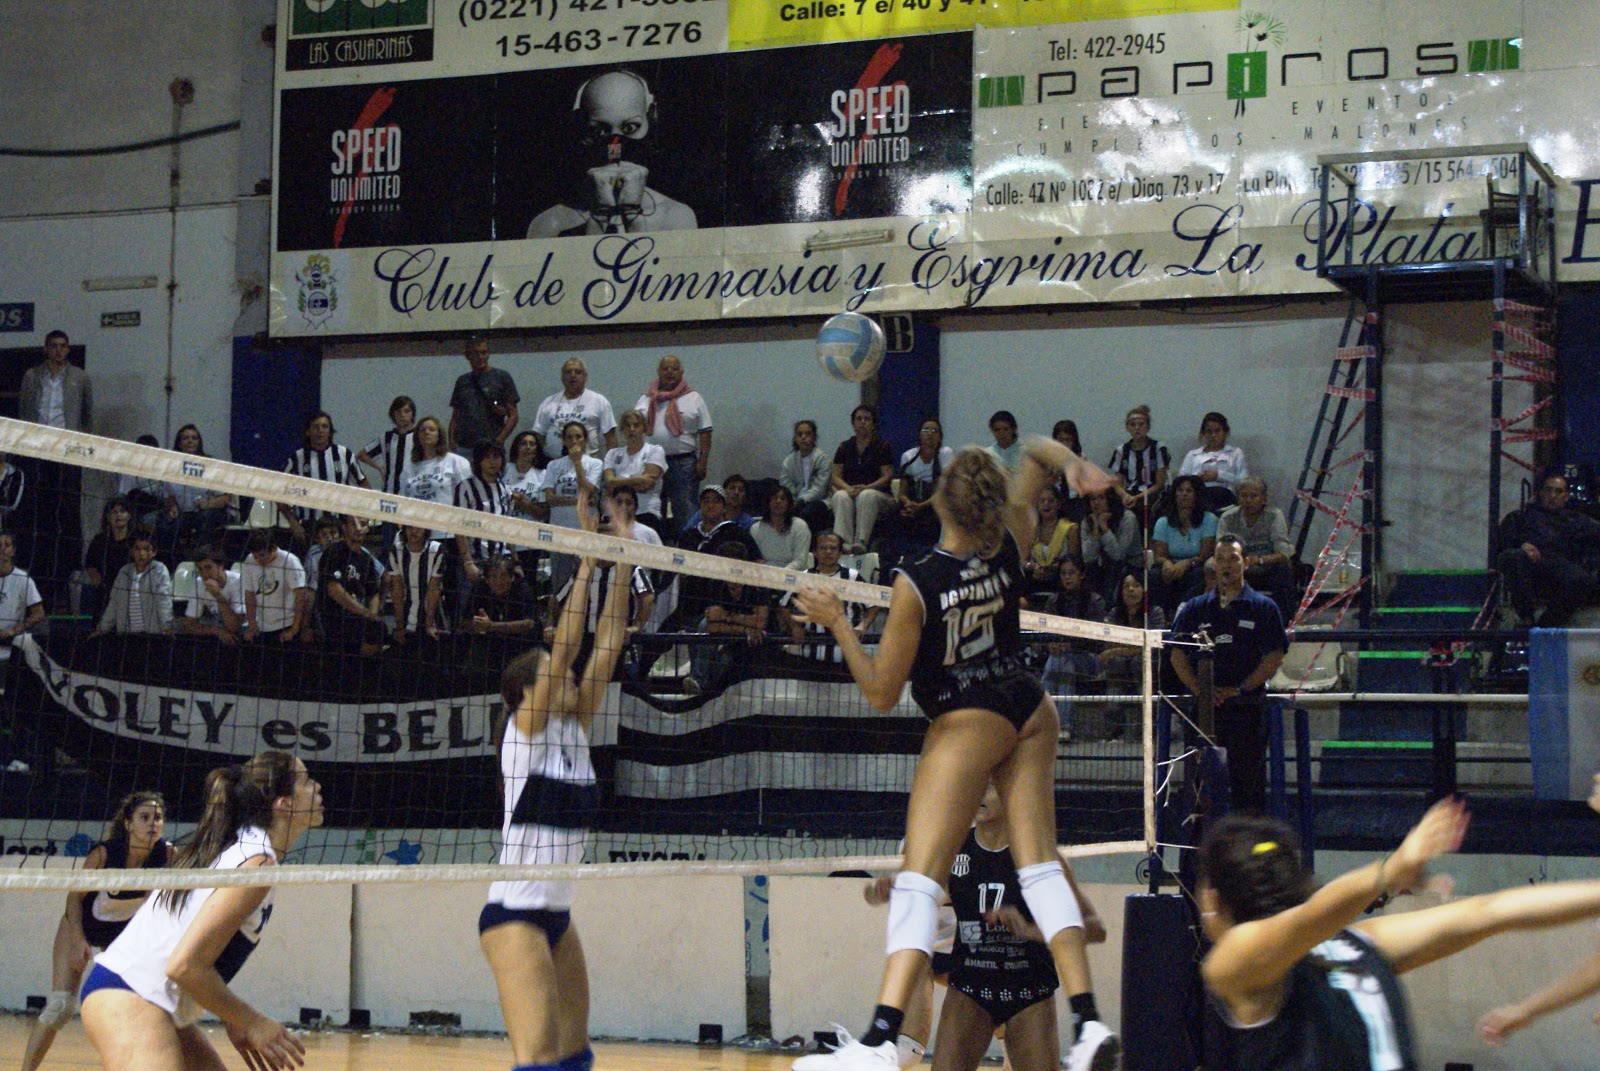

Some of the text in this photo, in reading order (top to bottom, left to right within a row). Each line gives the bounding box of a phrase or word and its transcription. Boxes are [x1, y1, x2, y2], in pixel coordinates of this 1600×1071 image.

[780, 2, 846, 21] Calle:
[309, 35, 414, 64] LAS CASUARINAS
[1048, 33, 1166, 61] Tel: 422-2945
[831, 85, 910, 138] SPEED
[331, 126, 402, 175] SPEED
[831, 136, 910, 167] UNLIMITED
[331, 174, 401, 202] UNLIMITED
[986, 184, 1023, 206] Calle:
[1172, 174, 1189, 196] 73
[1208, 172, 1225, 195] 17
[373, 198, 1480, 320] Club de Gimnasia y Esgrima La Plata
[942, 595, 1004, 665] 15
[261, 720, 332, 751] es
[978, 883, 1005, 914] 17
